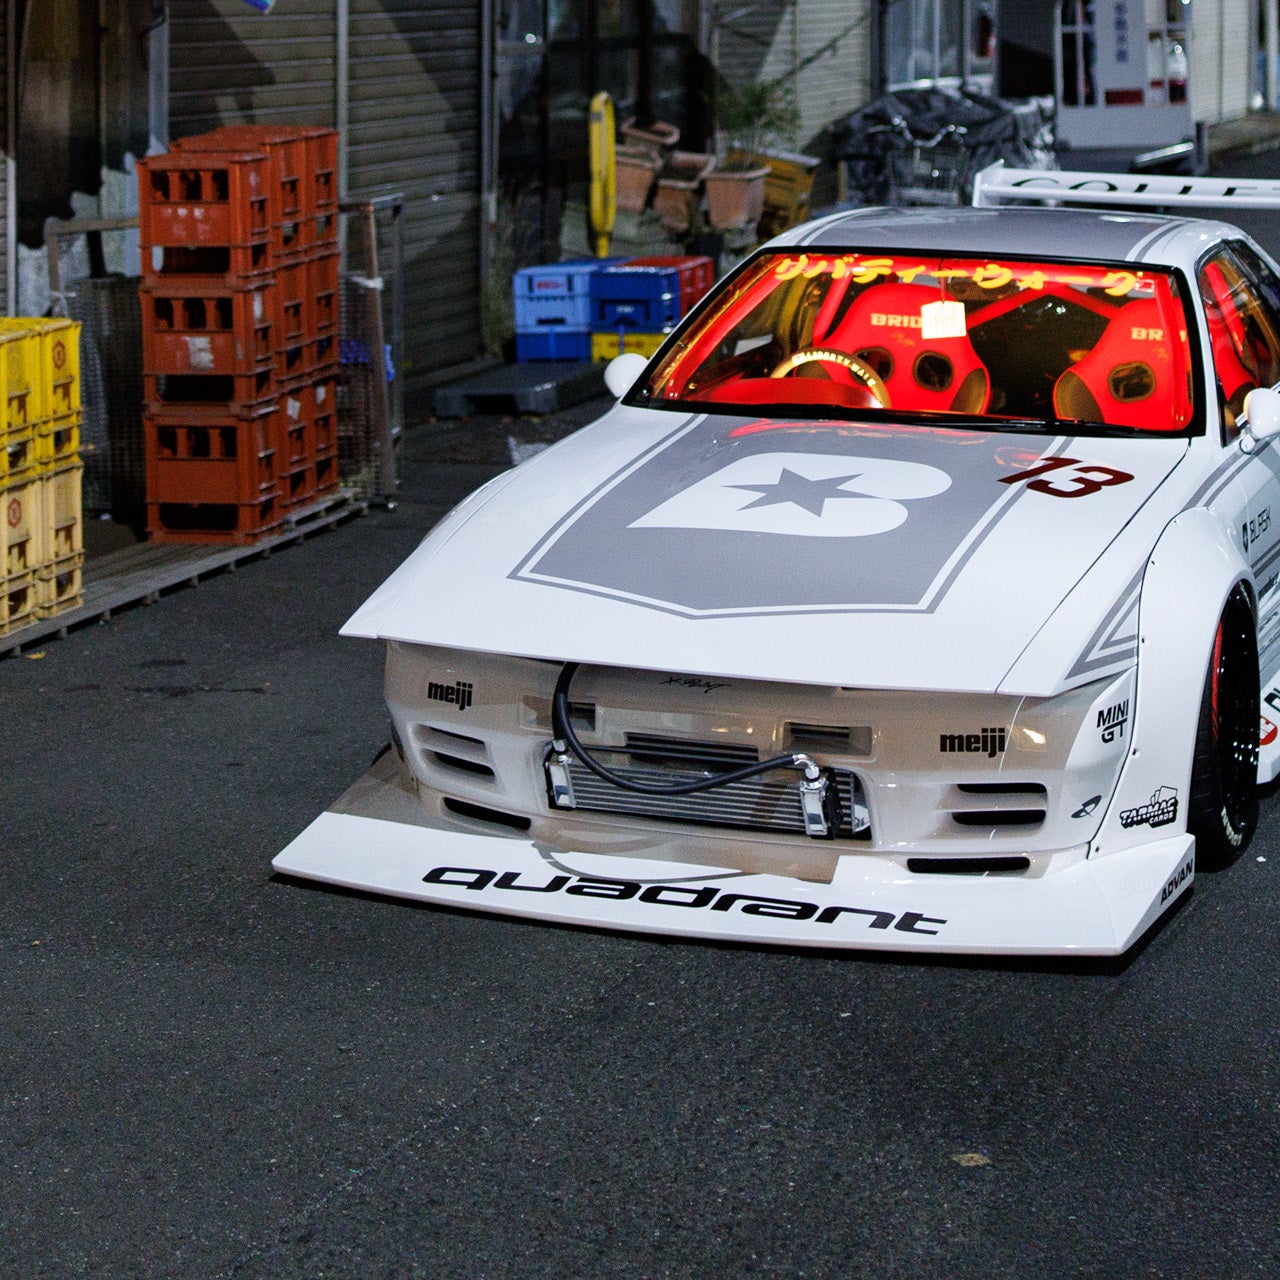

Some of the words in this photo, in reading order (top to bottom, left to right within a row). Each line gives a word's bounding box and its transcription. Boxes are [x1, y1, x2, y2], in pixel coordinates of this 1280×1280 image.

[774, 254, 1136, 297] リバティーウォーク
[870, 312, 922, 329] BRID
[996, 455, 1135, 498] 13
[427, 680, 473, 712] meiji
[1096, 698, 1130, 728] MINI
[939, 727, 1006, 758] meiji
[1101, 717, 1128, 744] GT
[1120, 797, 1178, 828] TARMAC
[1149, 810, 1177, 827] CARDS
[1161, 858, 1194, 905] ADVAN
[421, 865, 949, 936] quadrant
